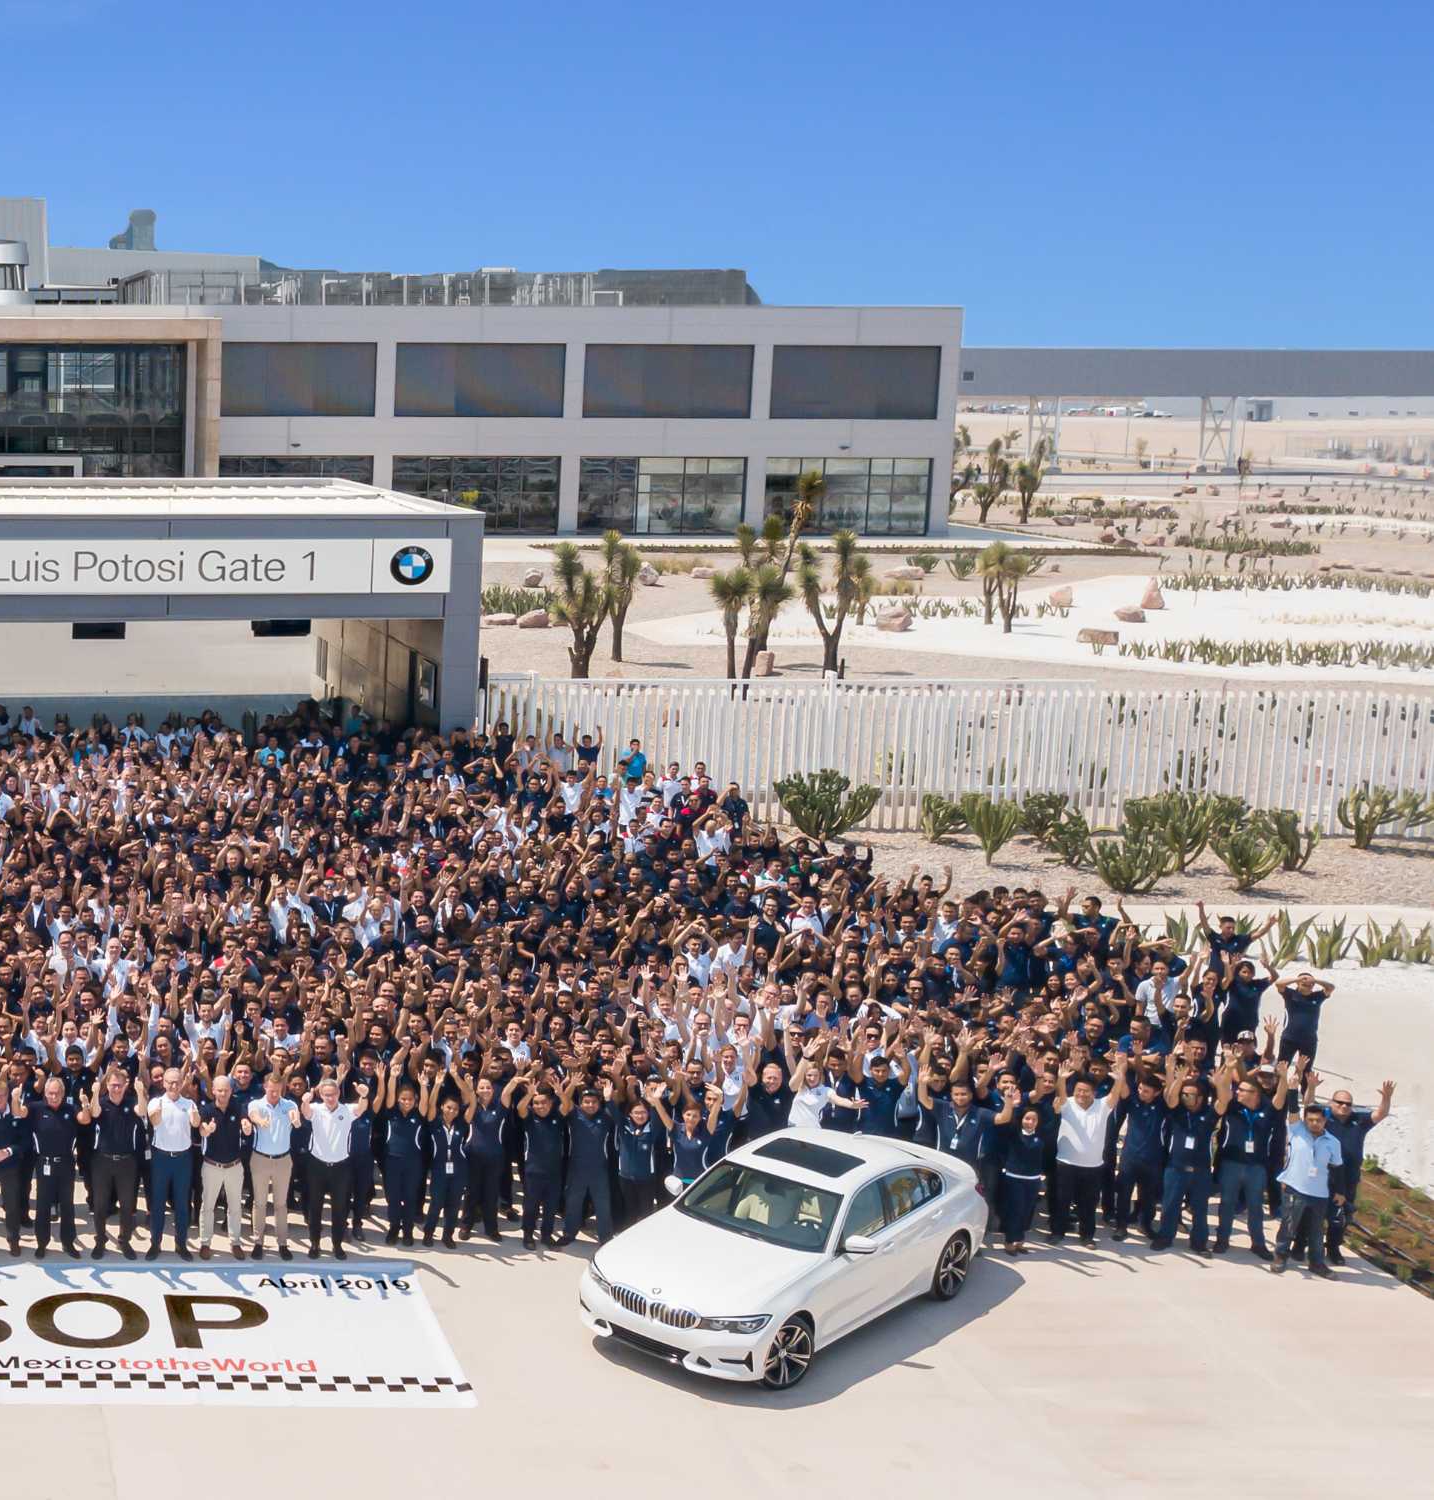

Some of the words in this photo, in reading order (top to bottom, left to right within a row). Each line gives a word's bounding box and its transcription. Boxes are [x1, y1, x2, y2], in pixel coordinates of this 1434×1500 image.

[73, 551, 184, 583] Potosi
[197, 550, 286, 583] Gate
[301, 551, 316, 582] 1
[258, 1277, 328, 1290] Abril
[336, 1278, 411, 1291] 2019
